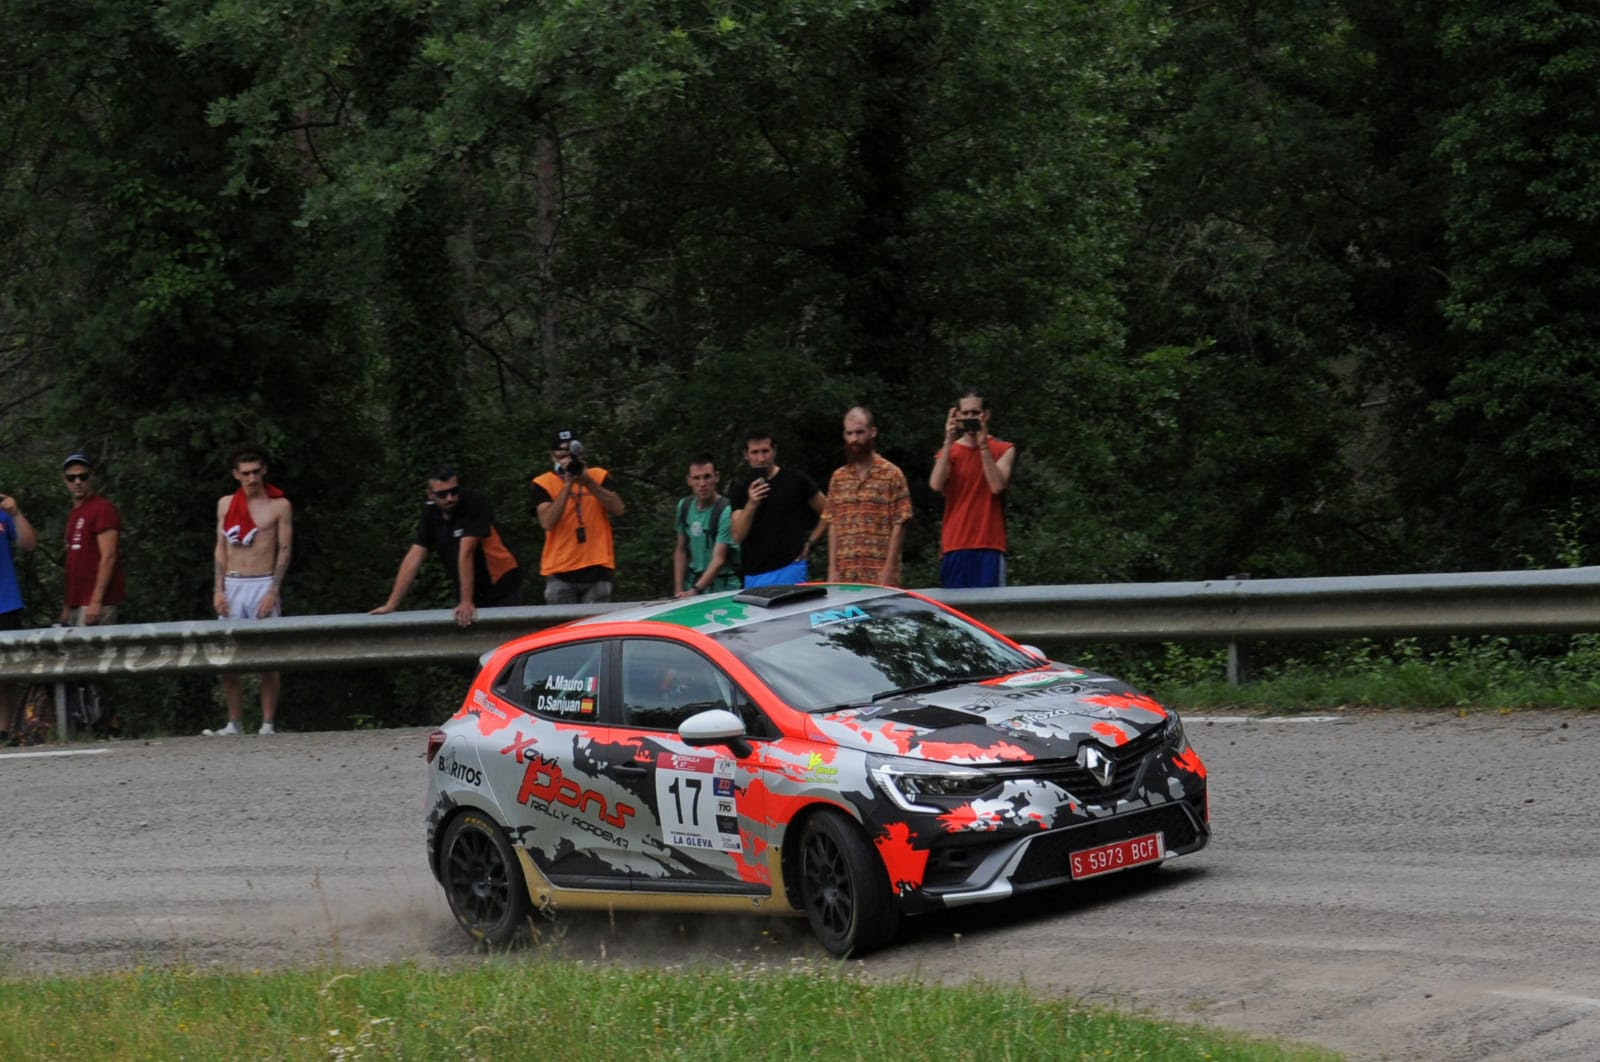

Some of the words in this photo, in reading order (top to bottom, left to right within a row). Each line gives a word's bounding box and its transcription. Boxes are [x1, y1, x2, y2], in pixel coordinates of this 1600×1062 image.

[545, 674, 584, 692] A.Mauro
[537, 695, 581, 715] D.Sanjuan
[529, 799, 570, 823] RALLY
[668, 776, 702, 827] 17
[673, 834, 685, 845] LA
[686, 836, 714, 849] GLEVA
[1073, 857, 1083, 873] S
[1088, 847, 1124, 871] 5973
[1131, 838, 1154, 861] BCF
